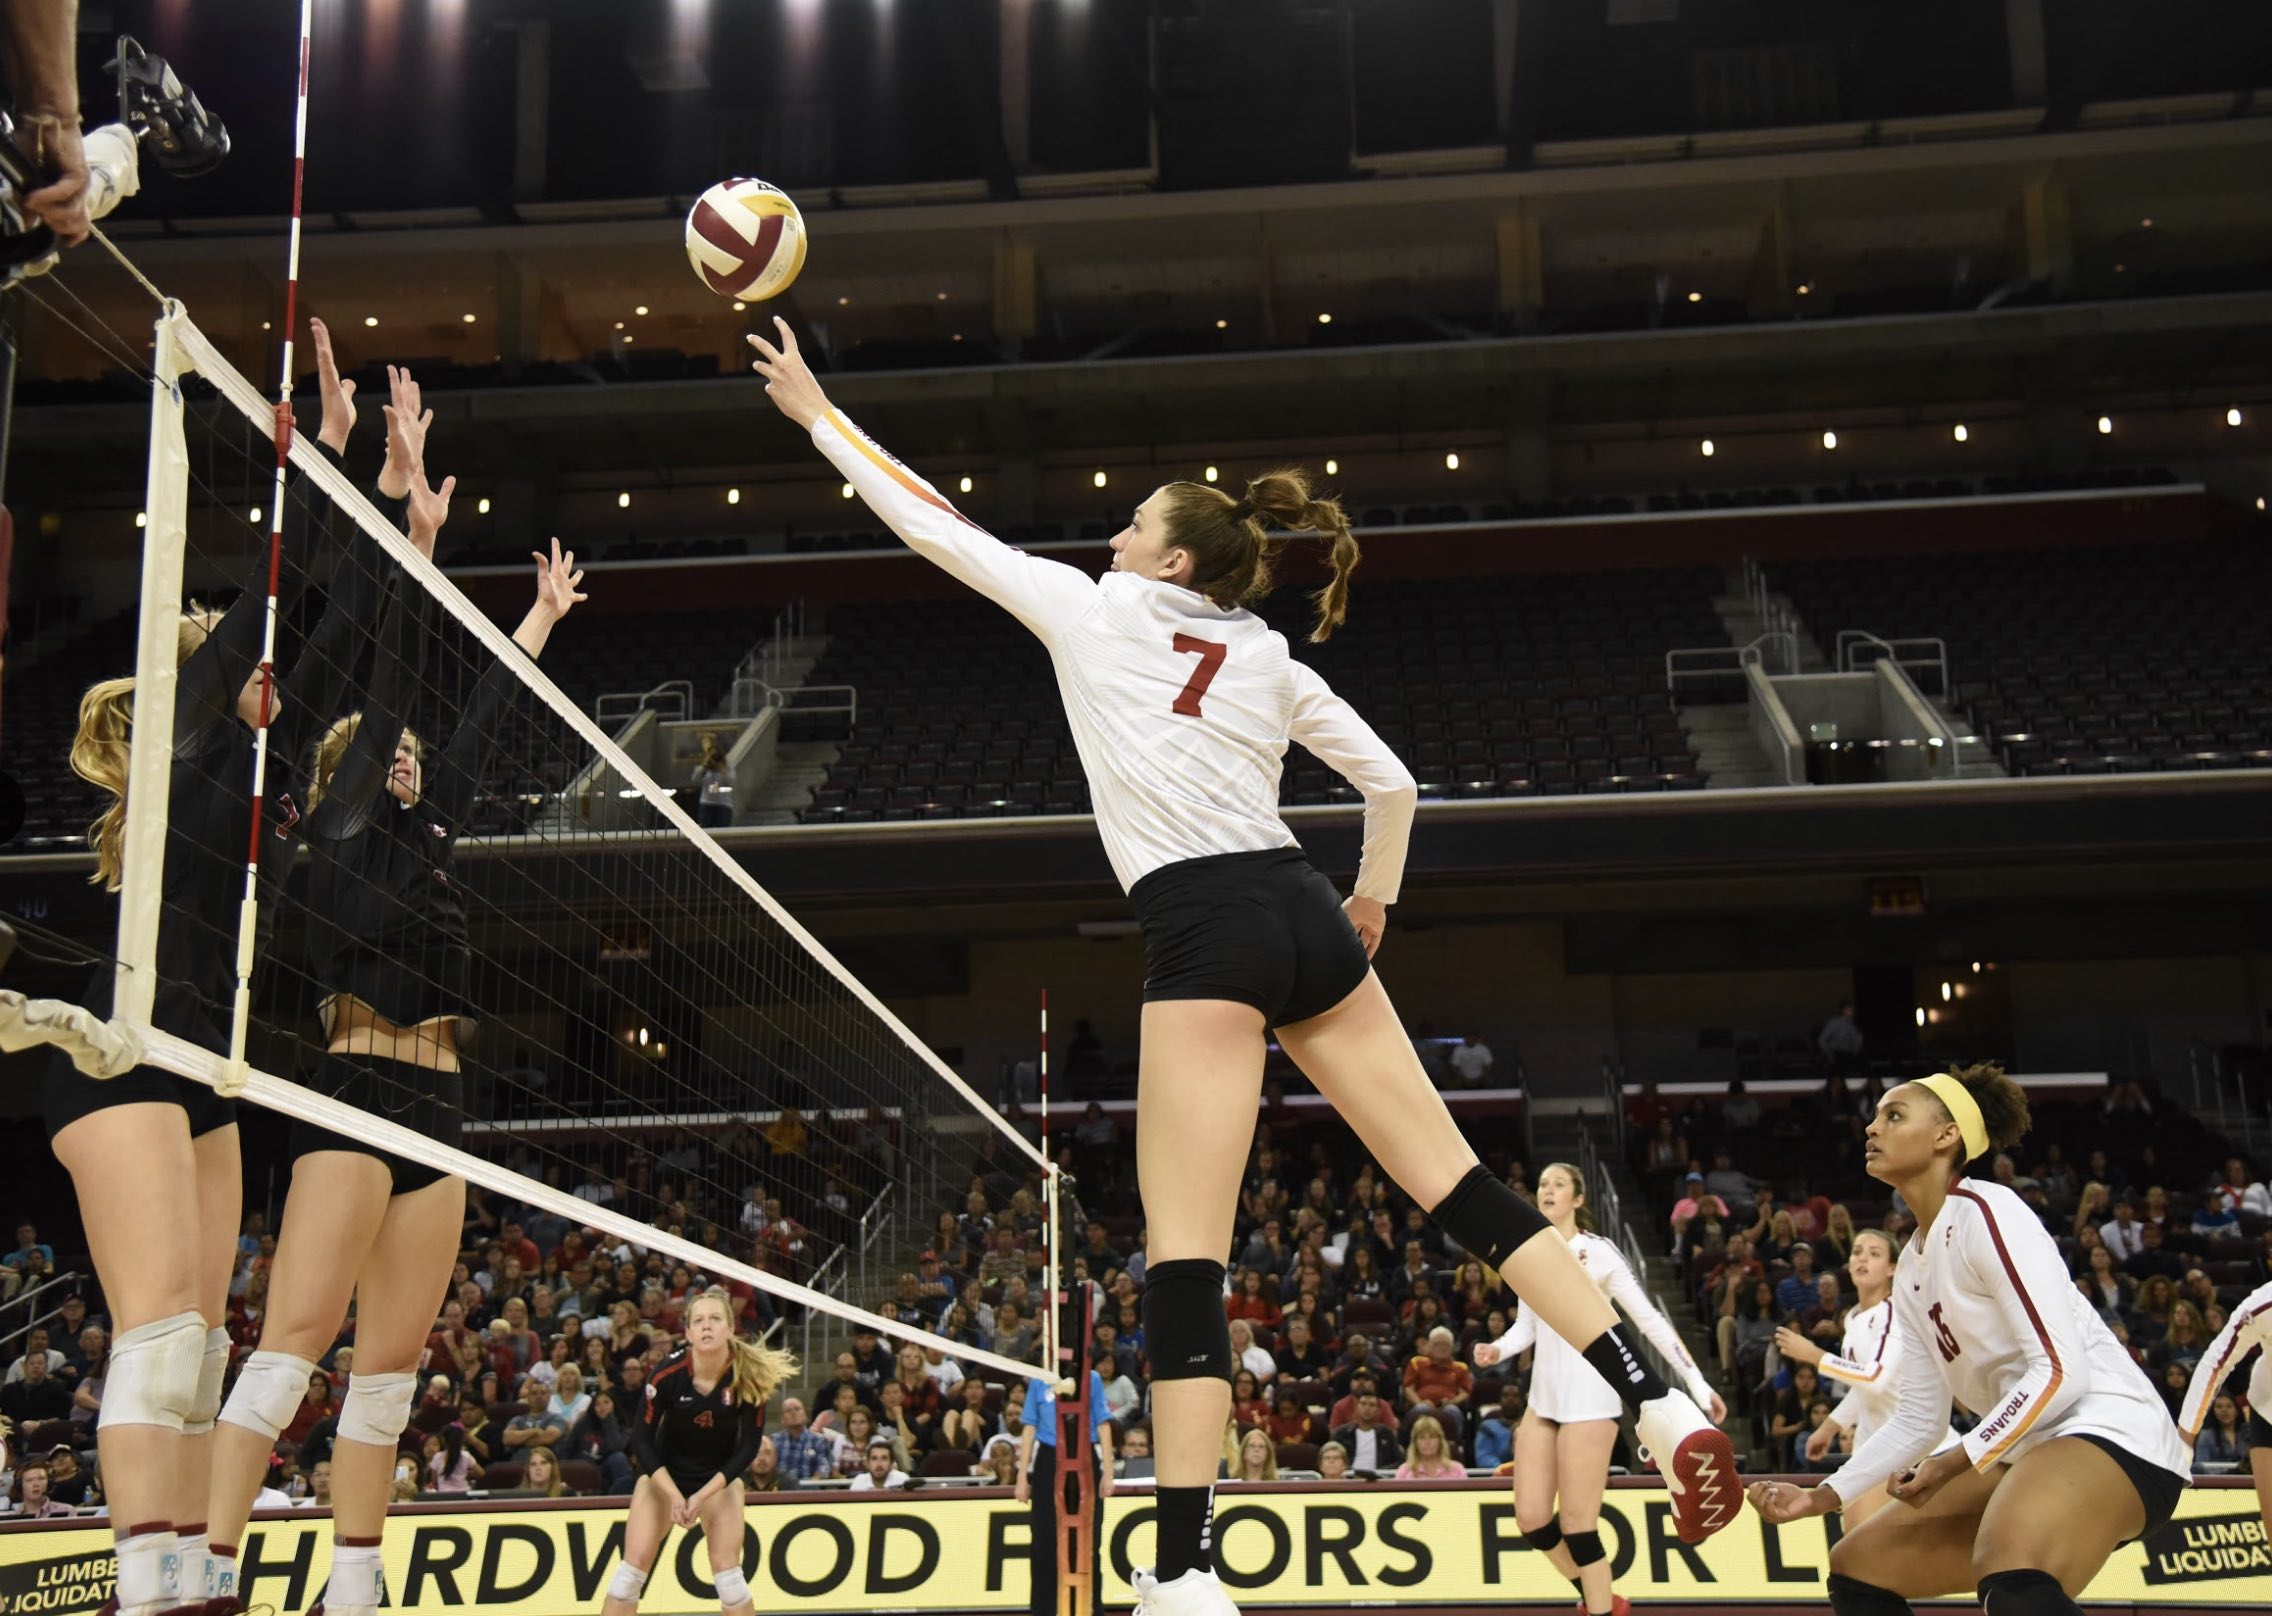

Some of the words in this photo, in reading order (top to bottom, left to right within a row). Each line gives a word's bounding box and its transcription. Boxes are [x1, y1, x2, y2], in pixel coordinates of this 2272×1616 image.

[1172, 632, 1227, 718] 7
[1928, 1301, 1961, 1363] 16
[693, 1410, 714, 1429] 4
[1979, 1390, 2029, 1442] TROJANS
[237, 1513, 941, 1612] HRDWOOD
